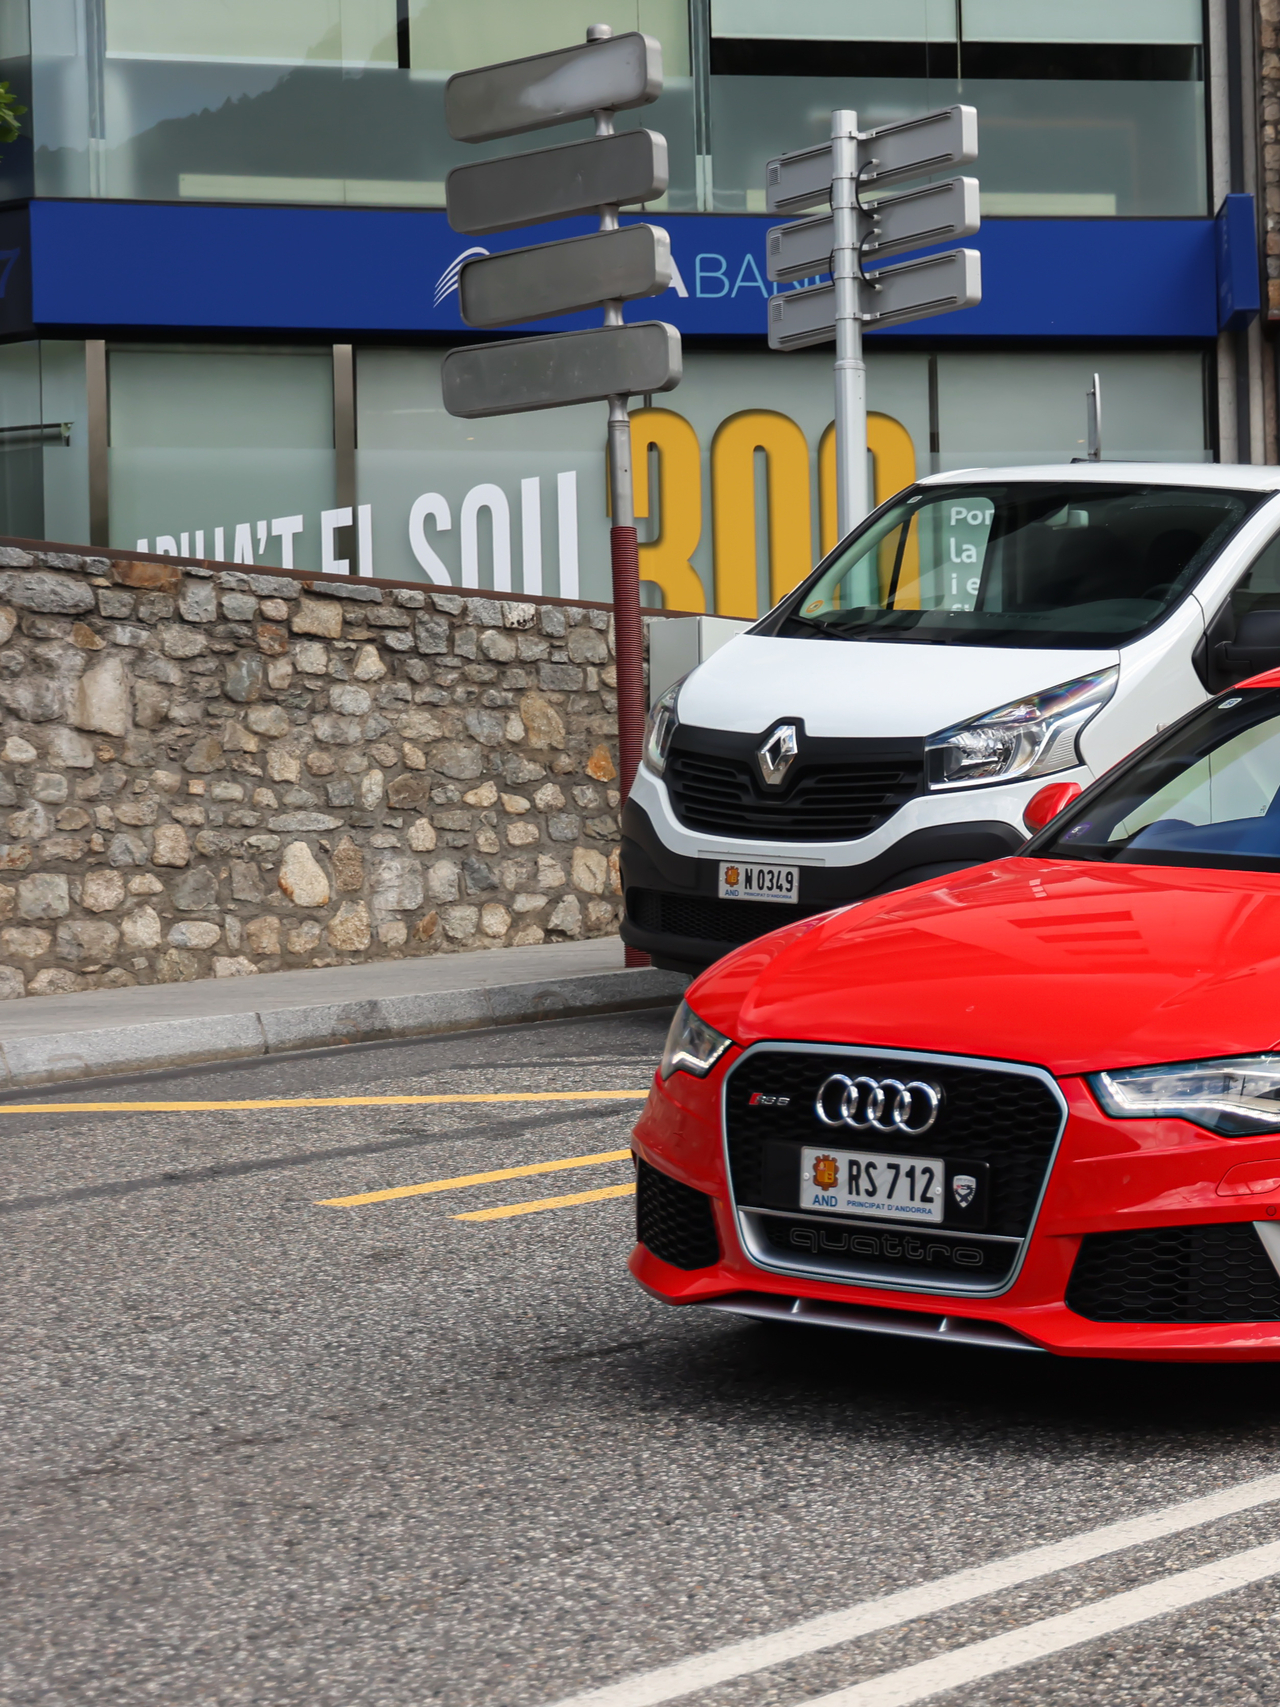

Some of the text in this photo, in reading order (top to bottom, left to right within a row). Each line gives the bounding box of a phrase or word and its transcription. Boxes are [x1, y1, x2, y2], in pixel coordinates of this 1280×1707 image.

[724, 889, 739, 897] AND
[812, 1194, 933, 1215] AND PRINCIPAT D'ANDORRA
[789, 1226, 984, 1267] quattro
